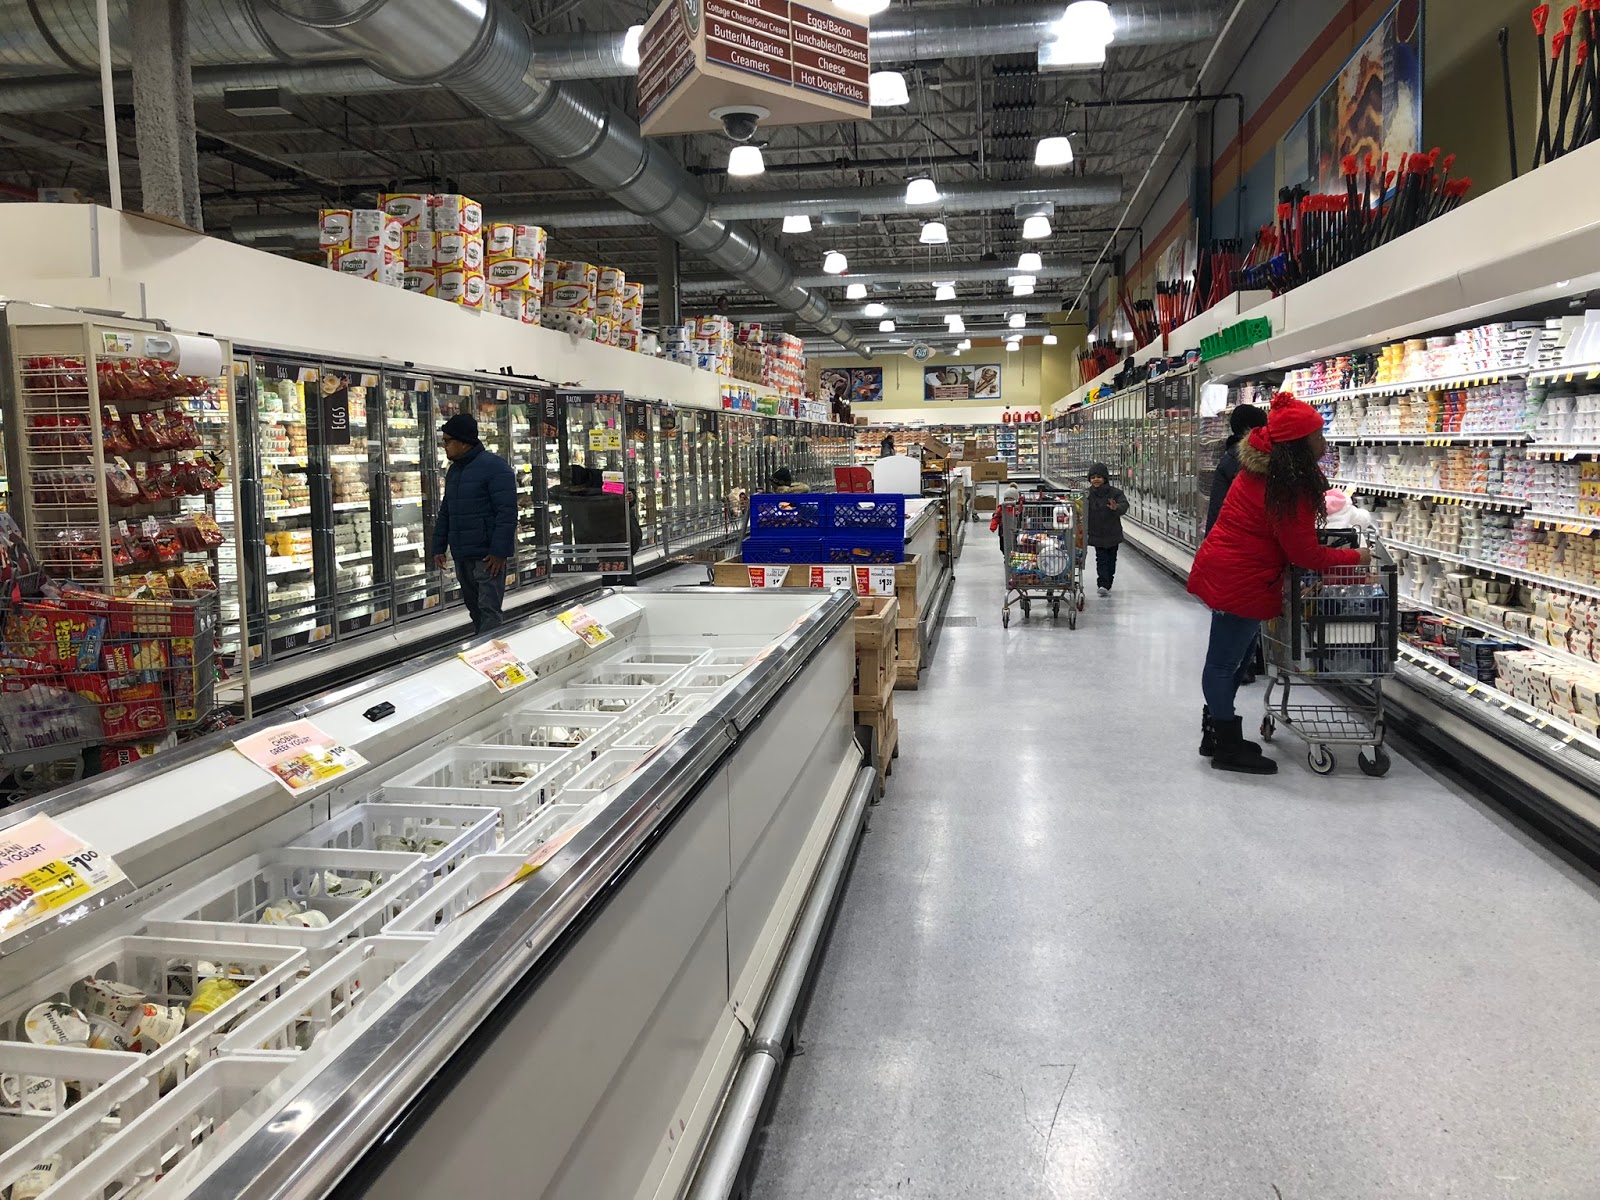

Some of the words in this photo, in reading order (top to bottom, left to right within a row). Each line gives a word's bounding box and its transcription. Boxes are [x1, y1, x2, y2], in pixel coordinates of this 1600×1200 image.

[706, 1, 730, 18] Cottage
[731, 10, 768, 29] Cheese/Sour
[769, 22, 788, 36] Cream
[807, 13, 852, 38] Eggs/Bacon
[714, 24, 784, 57] Butter/Margarine
[795, 29, 867, 62] Lunchables/Desserts
[731, 51, 771, 73] Creamers
[818, 57, 846, 75] Cheese
[801, 71, 816, 86] Hot
[817, 75, 864, 100] Dogs/Pickles
[494, 266, 517, 277] Marcal
[277, 365, 288, 378] EGGS
[546, 398, 555, 418] BACON
[566, 395, 581, 403] BACON
[331, 407, 346, 430] EGGS
[54, 618, 73, 660] PEBBLES
[87, 634, 97, 654] FREE
[269, 743, 292, 756] GREEK
[291, 736, 312, 748] YOGURT
[271, 733, 300, 747] CHOBANI
[5, 843, 46, 864] YOGURT
[333, 886, 363, 897] Chobani
